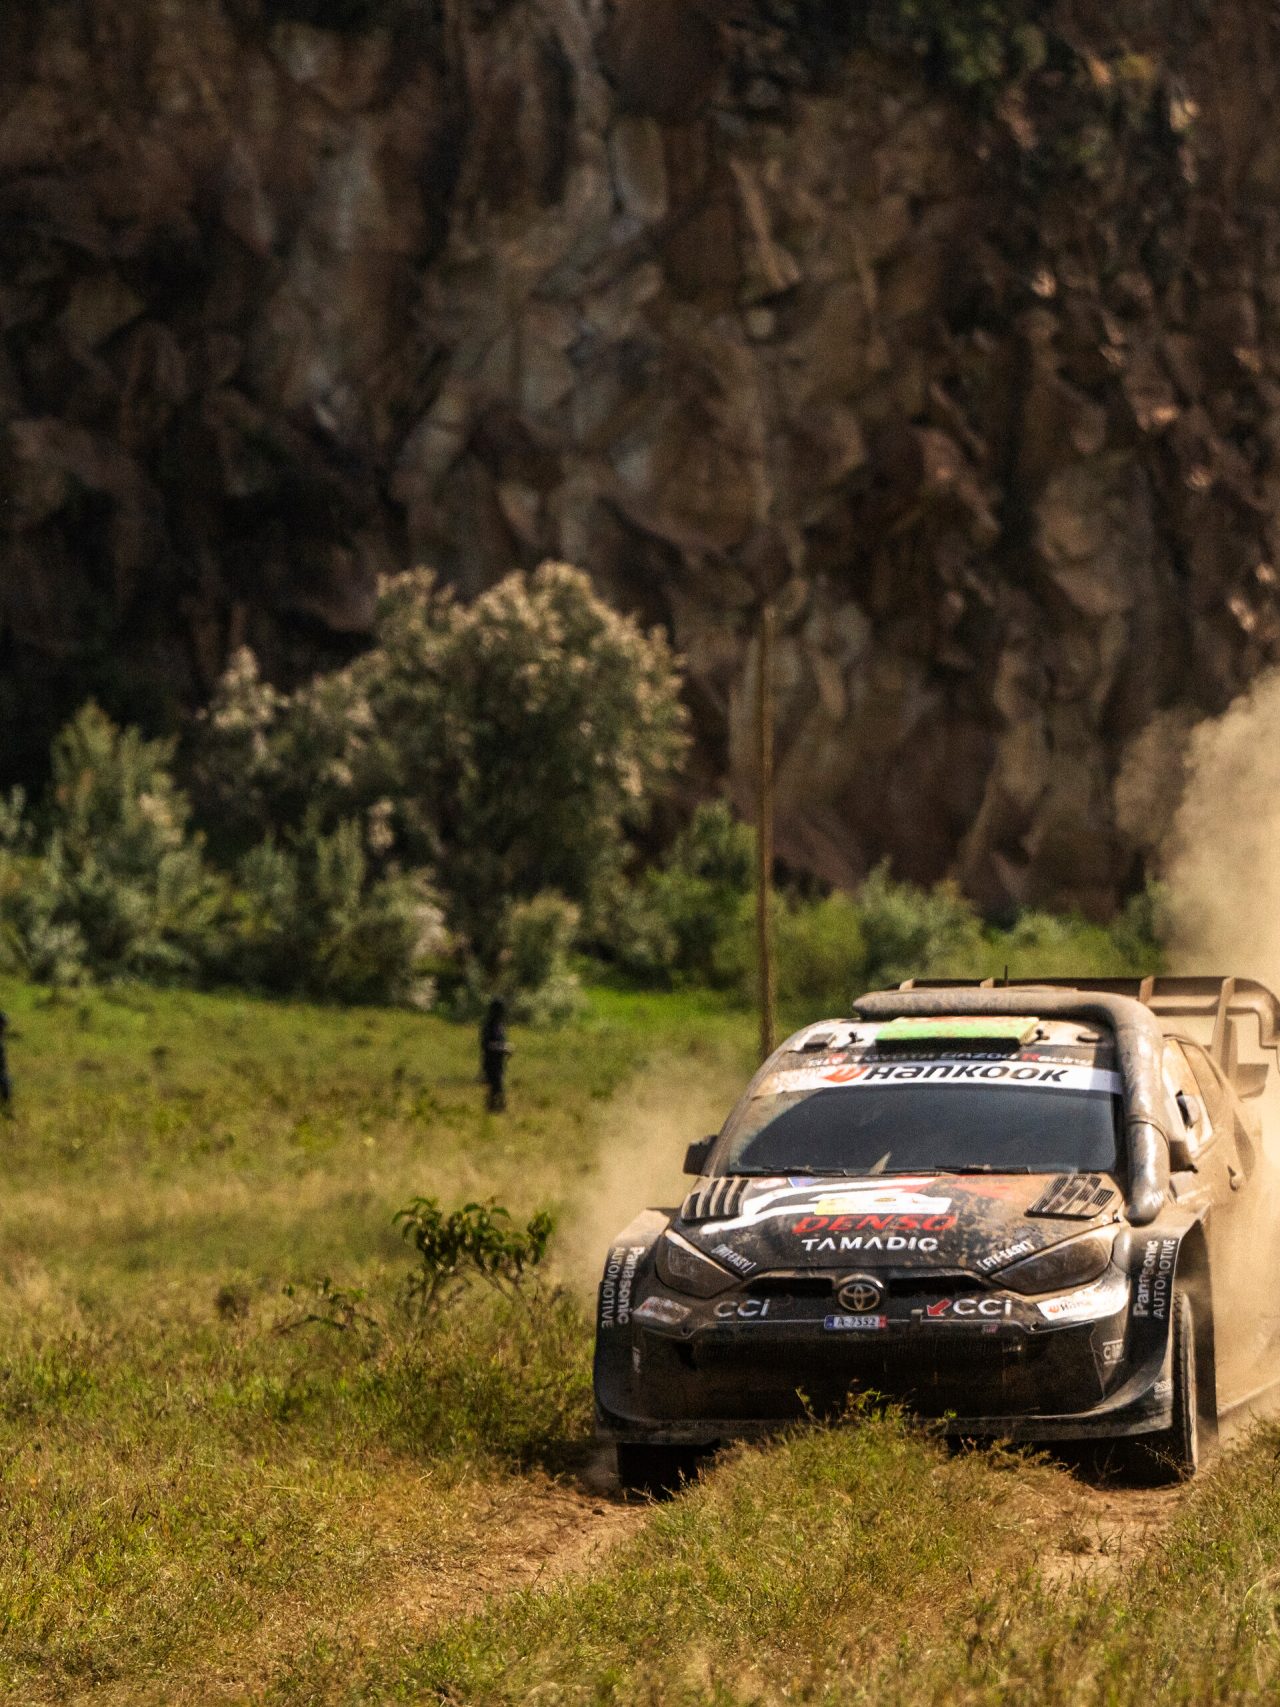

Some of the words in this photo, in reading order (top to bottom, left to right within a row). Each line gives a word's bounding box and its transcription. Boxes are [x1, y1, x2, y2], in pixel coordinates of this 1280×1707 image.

[792, 1214, 958, 1235] DENSO
[801, 1236, 939, 1252] TAMADIC
[601, 1246, 626, 1329] AUTOMOTIVE
[617, 1246, 645, 1325] Panasonic
[1133, 1240, 1159, 1317] Panasonic
[1152, 1239, 1177, 1320] AUTOMOTIVE
